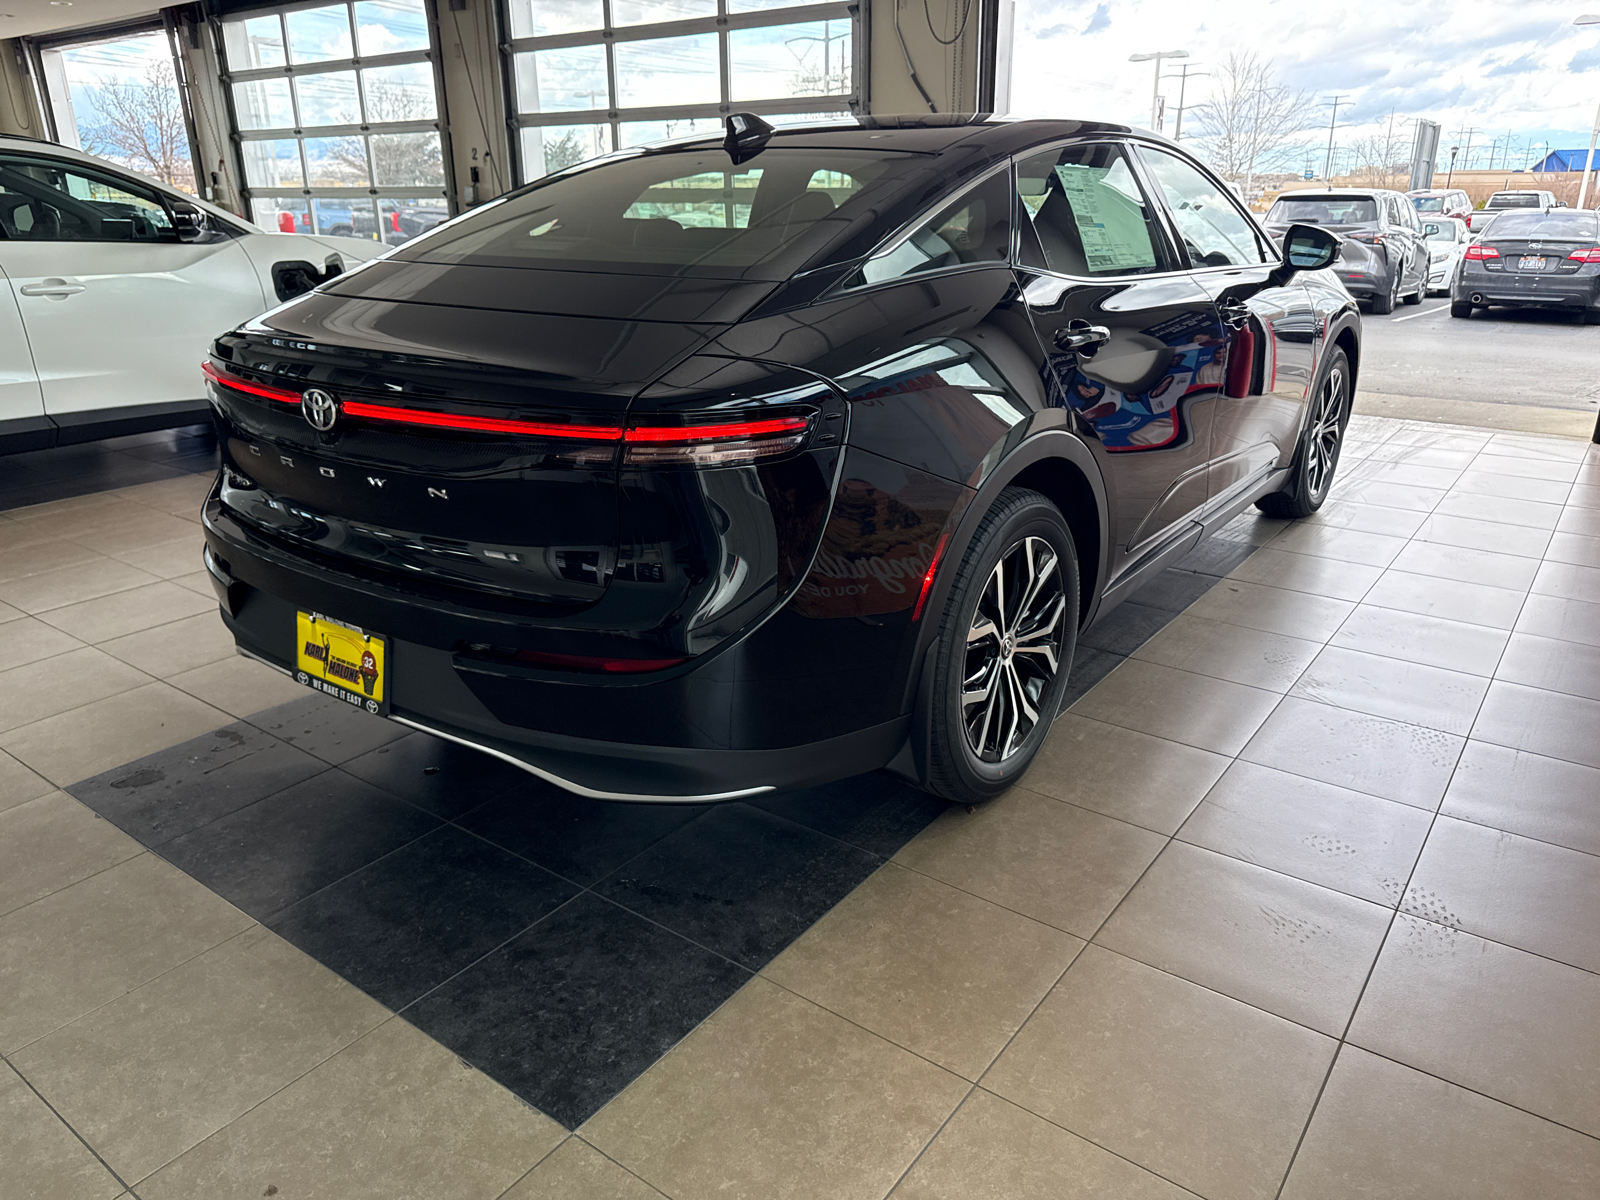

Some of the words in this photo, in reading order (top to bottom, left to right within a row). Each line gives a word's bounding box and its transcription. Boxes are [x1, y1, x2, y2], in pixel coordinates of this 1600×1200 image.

[472, 147, 478, 160] 2
[249, 445, 449, 500] CROWN
[304, 641, 325, 662] KARL
[363, 656, 374, 669] 32
[328, 659, 360, 685] MALONE
[312, 678, 322, 690] WE
[322, 682, 339, 698] MAKE
[339, 689, 346, 700] IT
[346, 691, 362, 707] EASY
